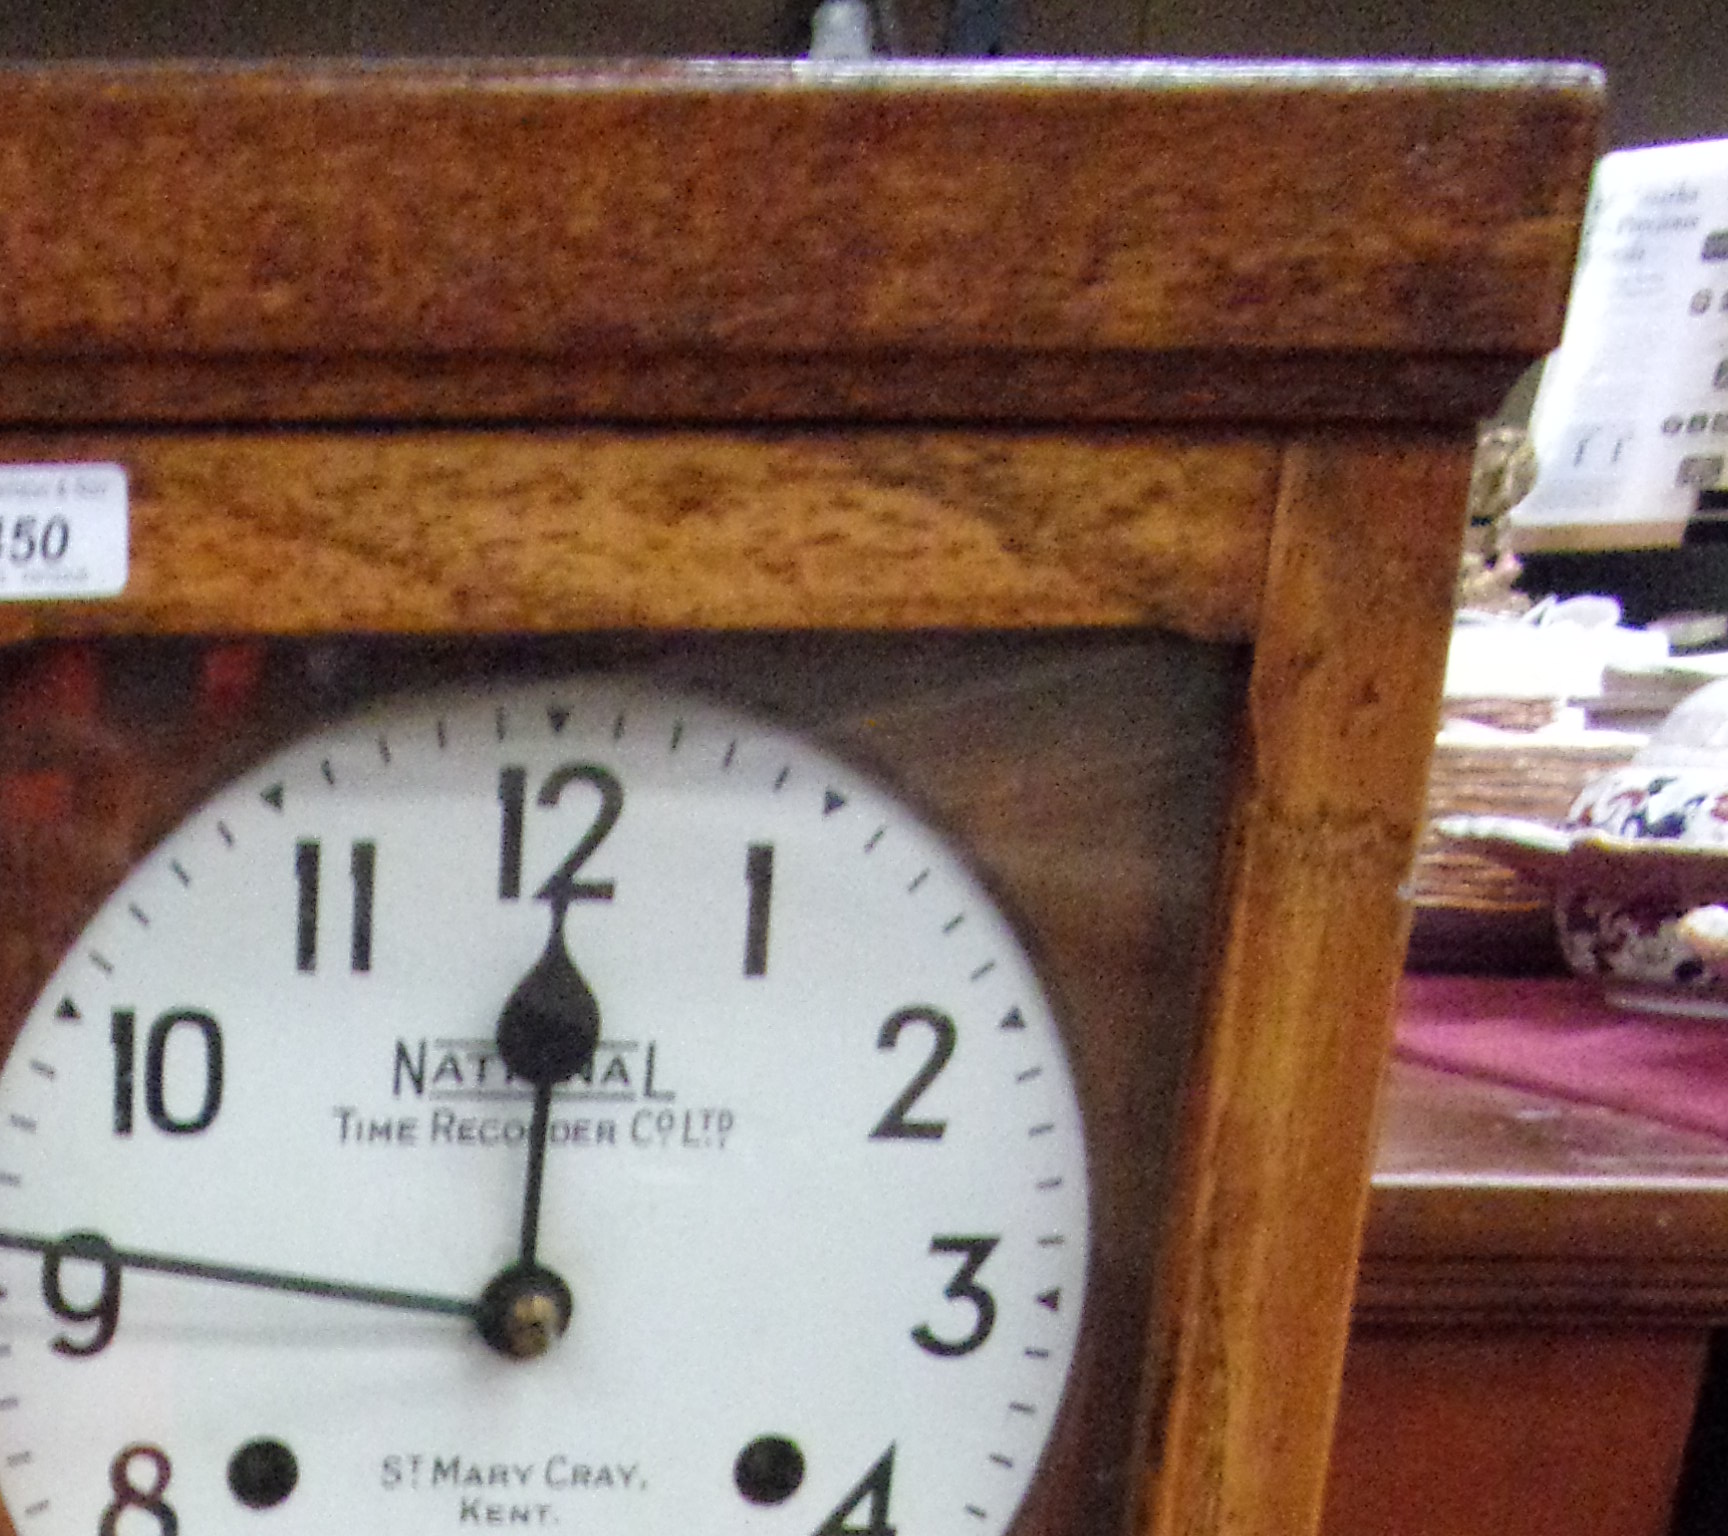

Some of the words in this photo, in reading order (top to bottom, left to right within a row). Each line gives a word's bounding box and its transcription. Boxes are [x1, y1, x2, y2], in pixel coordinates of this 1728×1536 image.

[498, 764, 623, 900] 12
[294, 837, 377, 974] 11
[744, 844, 775, 977] 1
[111, 1007, 224, 1138] 10
[430, 1105, 617, 1149] RECODER
[869, 1005, 958, 1141] 2
[42, 1238, 122, 1358] 9
[911, 1234, 1003, 1359] 3
